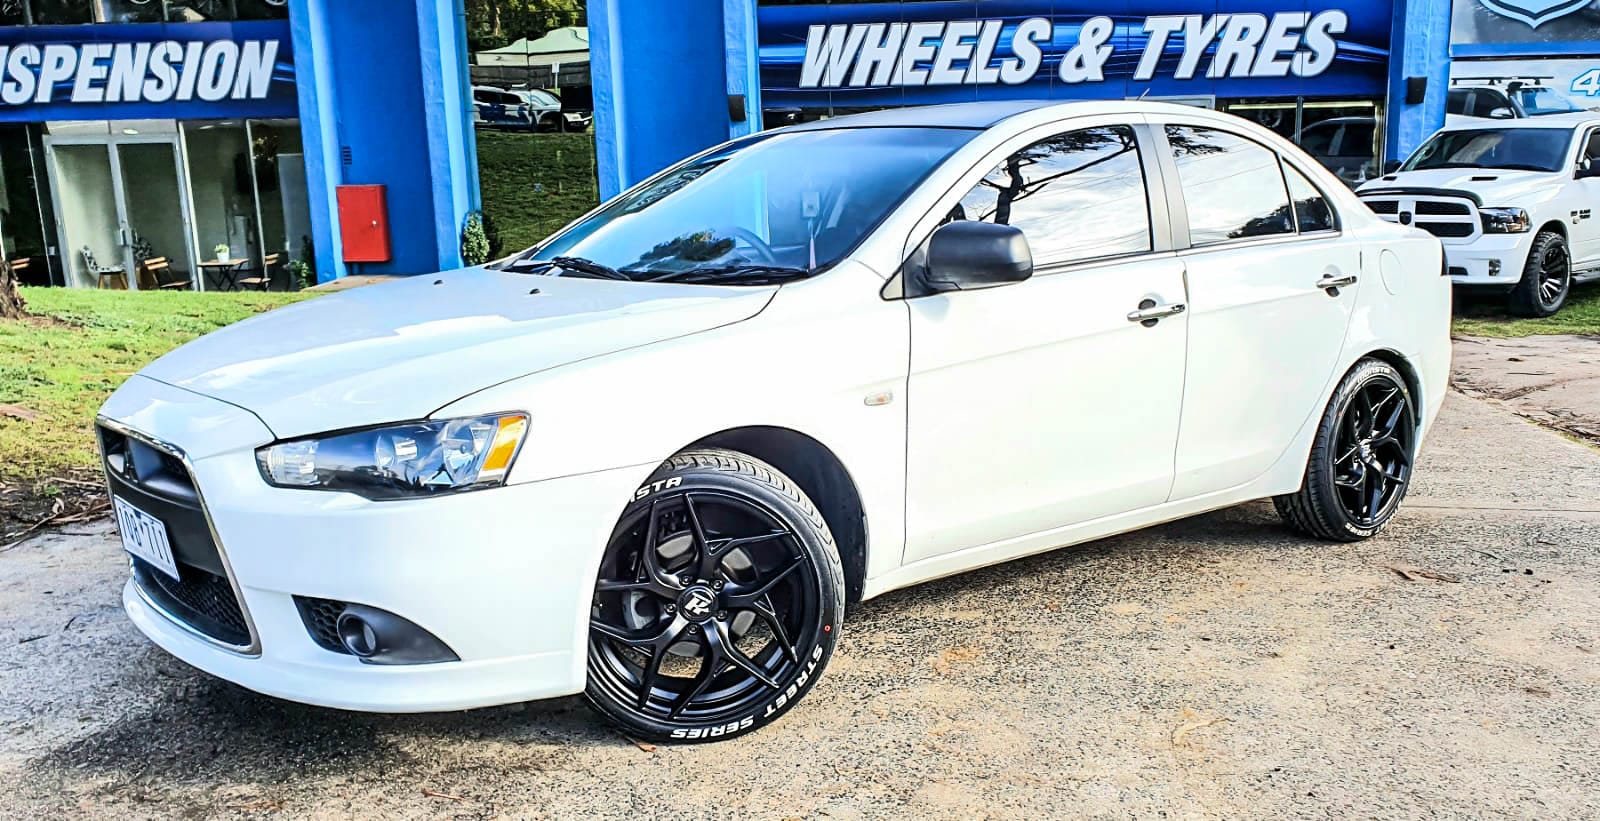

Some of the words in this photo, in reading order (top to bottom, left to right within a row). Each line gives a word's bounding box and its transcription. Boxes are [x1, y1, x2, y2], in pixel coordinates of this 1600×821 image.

[800, 17, 1053, 88] WHEELS
[1058, 15, 1113, 83] &
[1134, 9, 1349, 81] TYRES
[764, 644, 823, 719] STREET
[670, 714, 754, 739] SERIES
